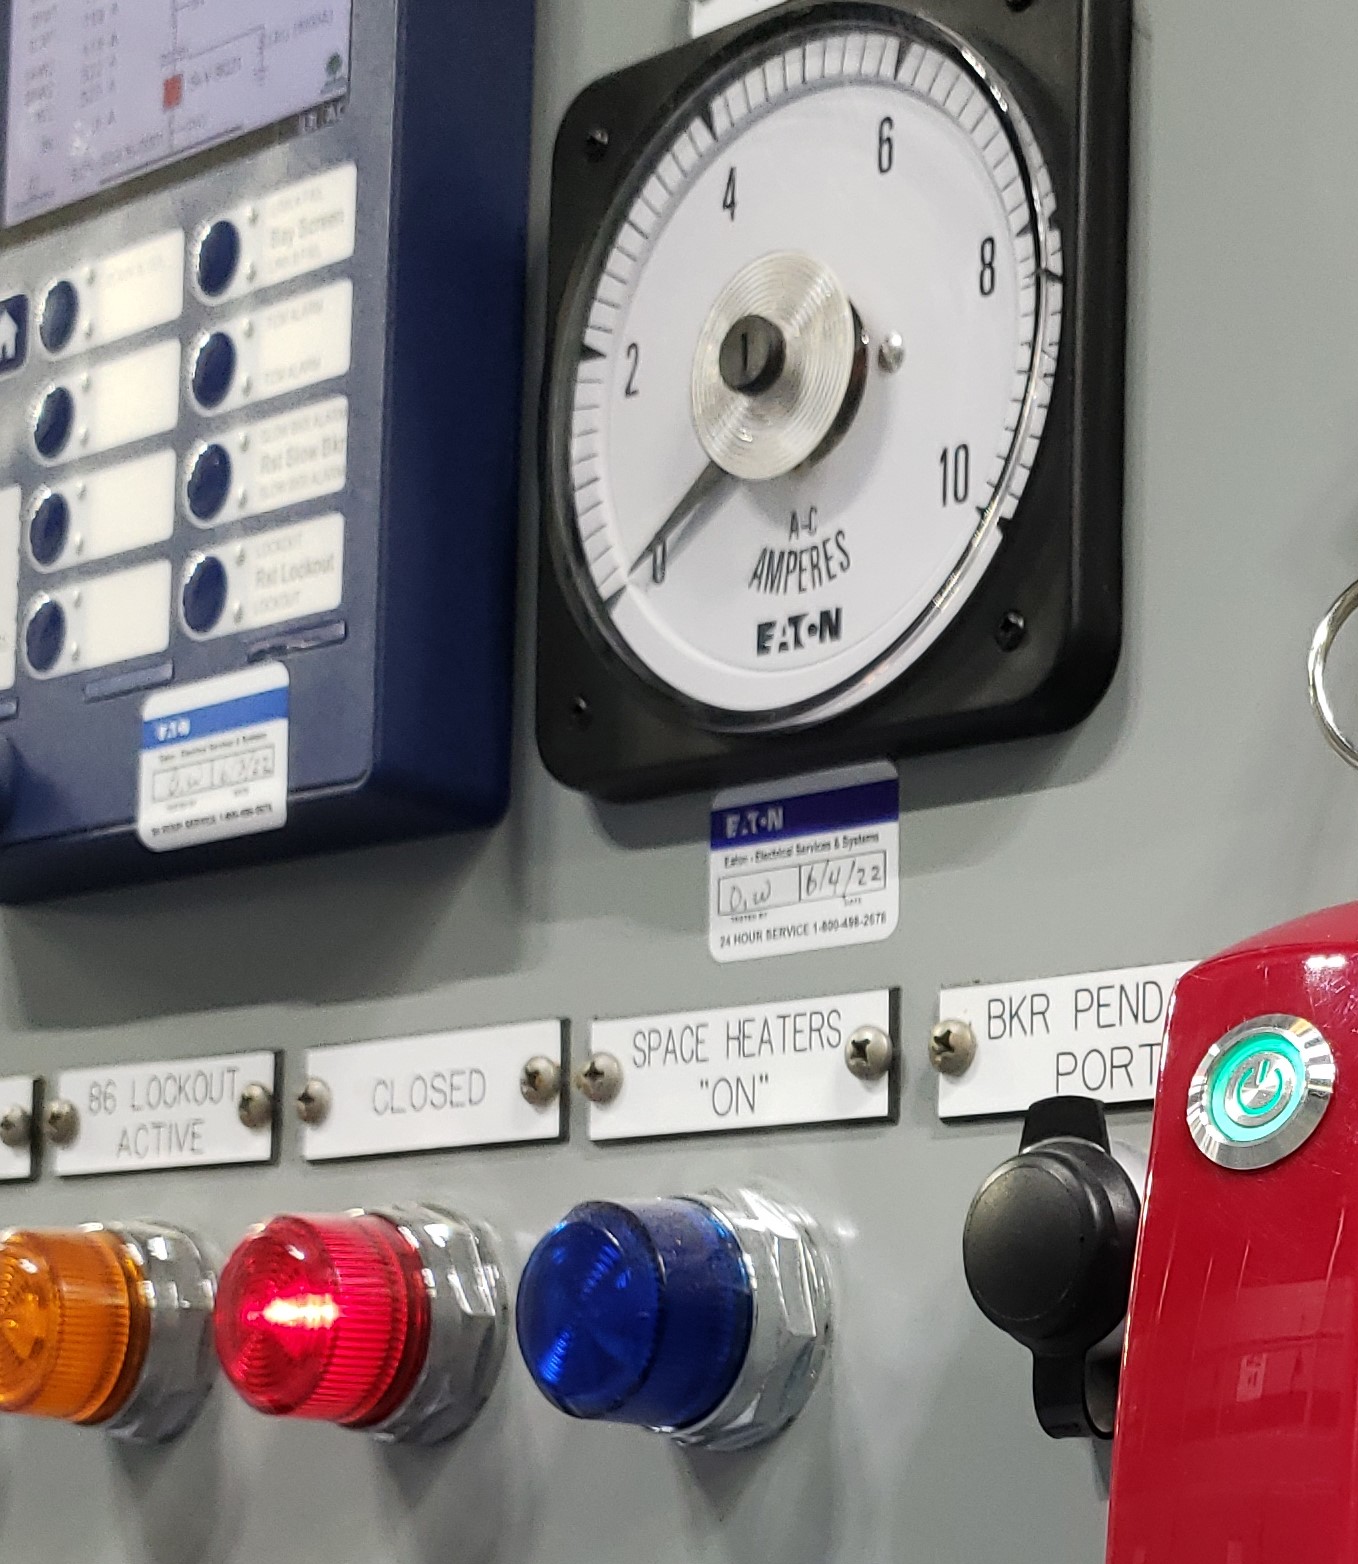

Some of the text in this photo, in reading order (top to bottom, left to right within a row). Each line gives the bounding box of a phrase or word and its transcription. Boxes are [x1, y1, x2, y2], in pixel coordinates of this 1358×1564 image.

[877, 116, 896, 175] 6
[722, 167, 738, 221] 4
[979, 237, 996, 297] 8
[625, 343, 640, 398] 2
[940, 444, 971, 507] 10
[748, 529, 852, 596] AMPERES
[806, 858, 882, 899] 6/4/22
[720, 935, 731, 949] 24
[733, 928, 763, 946] HOUR
[766, 923, 809, 941] SERVICE
[632, 1009, 842, 1068] SPACE HEATERS
[986, 993, 1051, 1041] BKR
[130, 1066, 240, 1112] LOCKOUT
[373, 1067, 486, 1115] CLOSED
[1056, 1043, 1162, 1094] PORT
[700, 1074, 769, 1117] "ON"
[116, 1119, 204, 1159] ACTIVE
